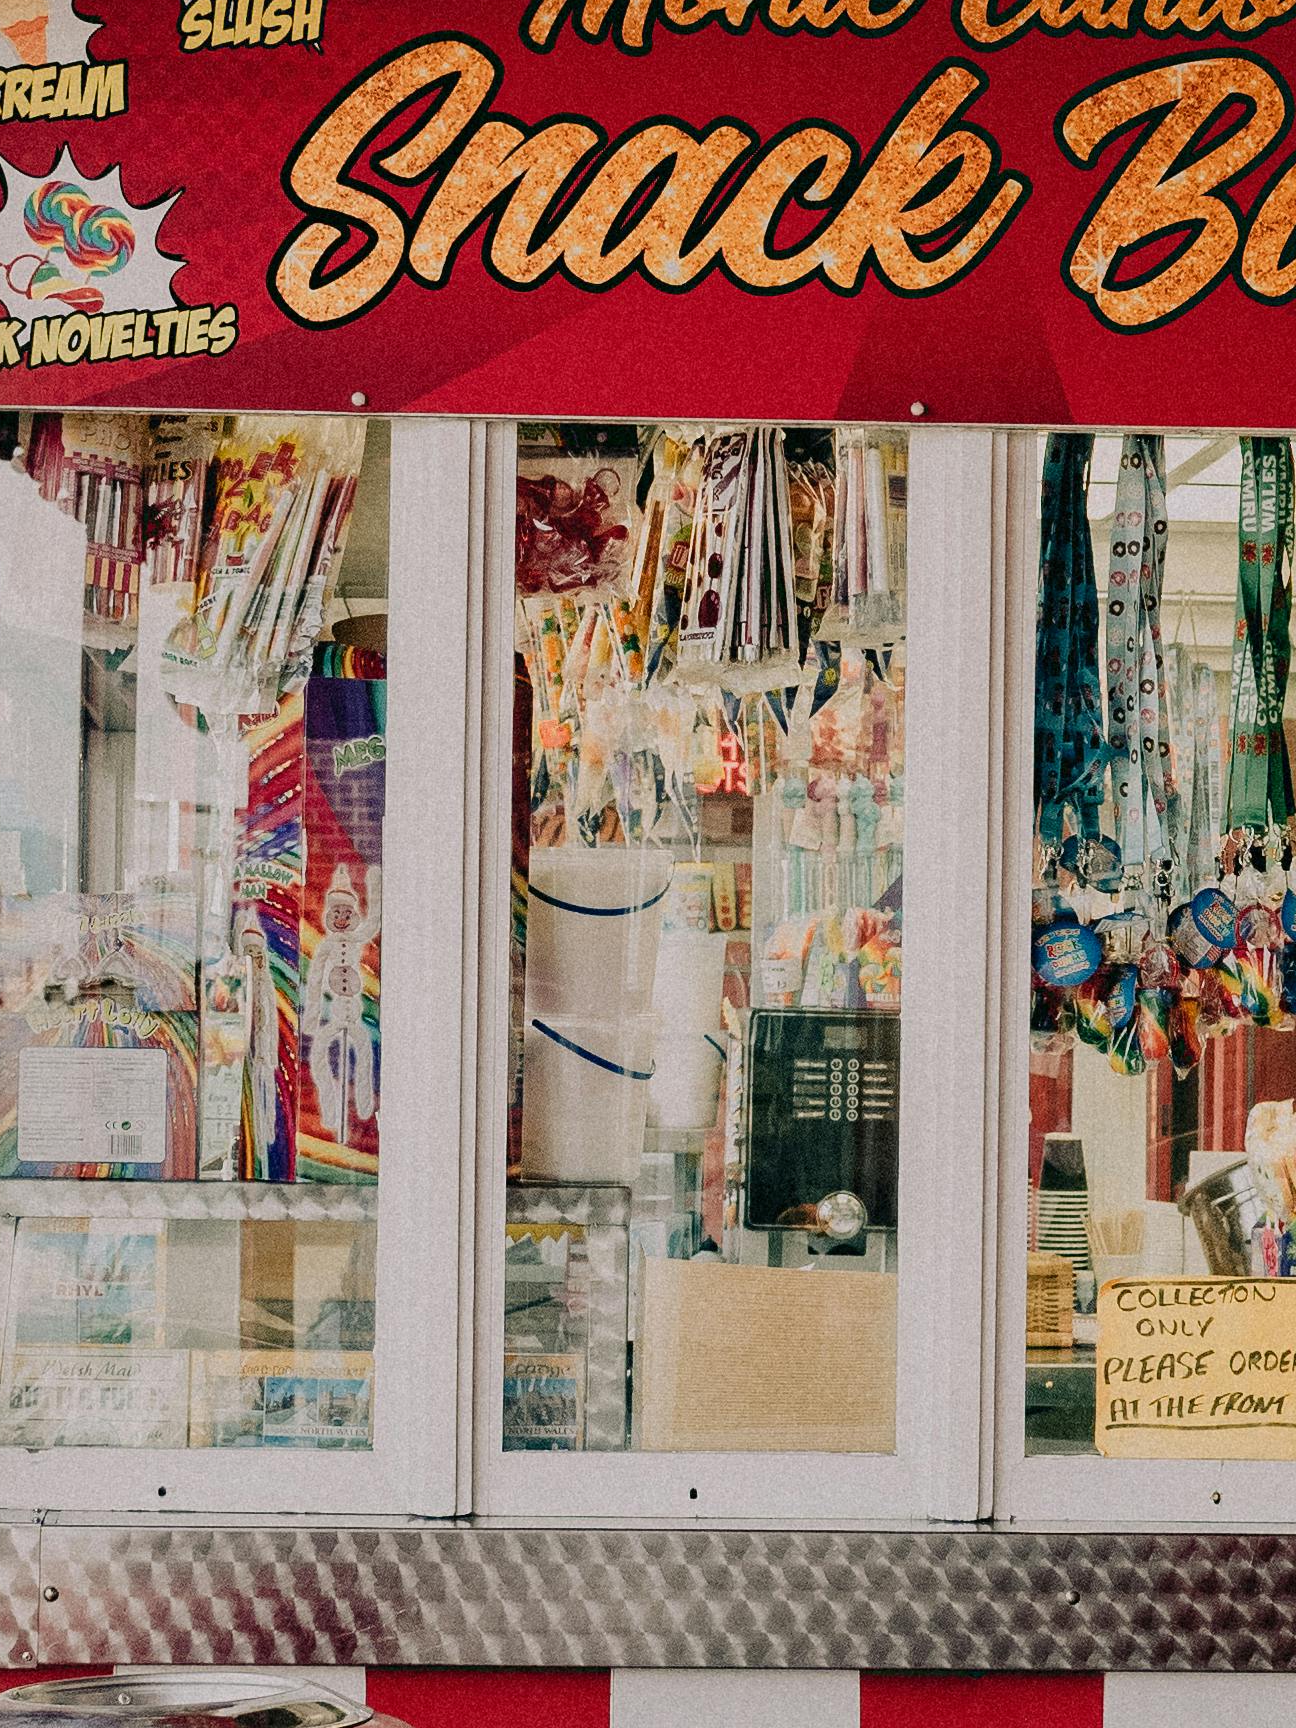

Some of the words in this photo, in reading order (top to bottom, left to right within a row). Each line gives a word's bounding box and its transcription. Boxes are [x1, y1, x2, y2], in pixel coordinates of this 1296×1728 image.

[268, 32, 1032, 332] Snack
[28, 303, 239, 368] NOVELTIES
[1242, 450, 1257, 533] CYMRU
[1261, 454, 1277, 533] WALES
[1117, 1284, 1276, 1312] COLLECTION
[1136, 1316, 1214, 1338] ONLY
[1104, 1350, 1215, 1385] PLEASE
[1110, 1398, 1139, 1422] AT
[1149, 1394, 1204, 1419] THE
[1209, 1392, 1292, 1417] FRONT
